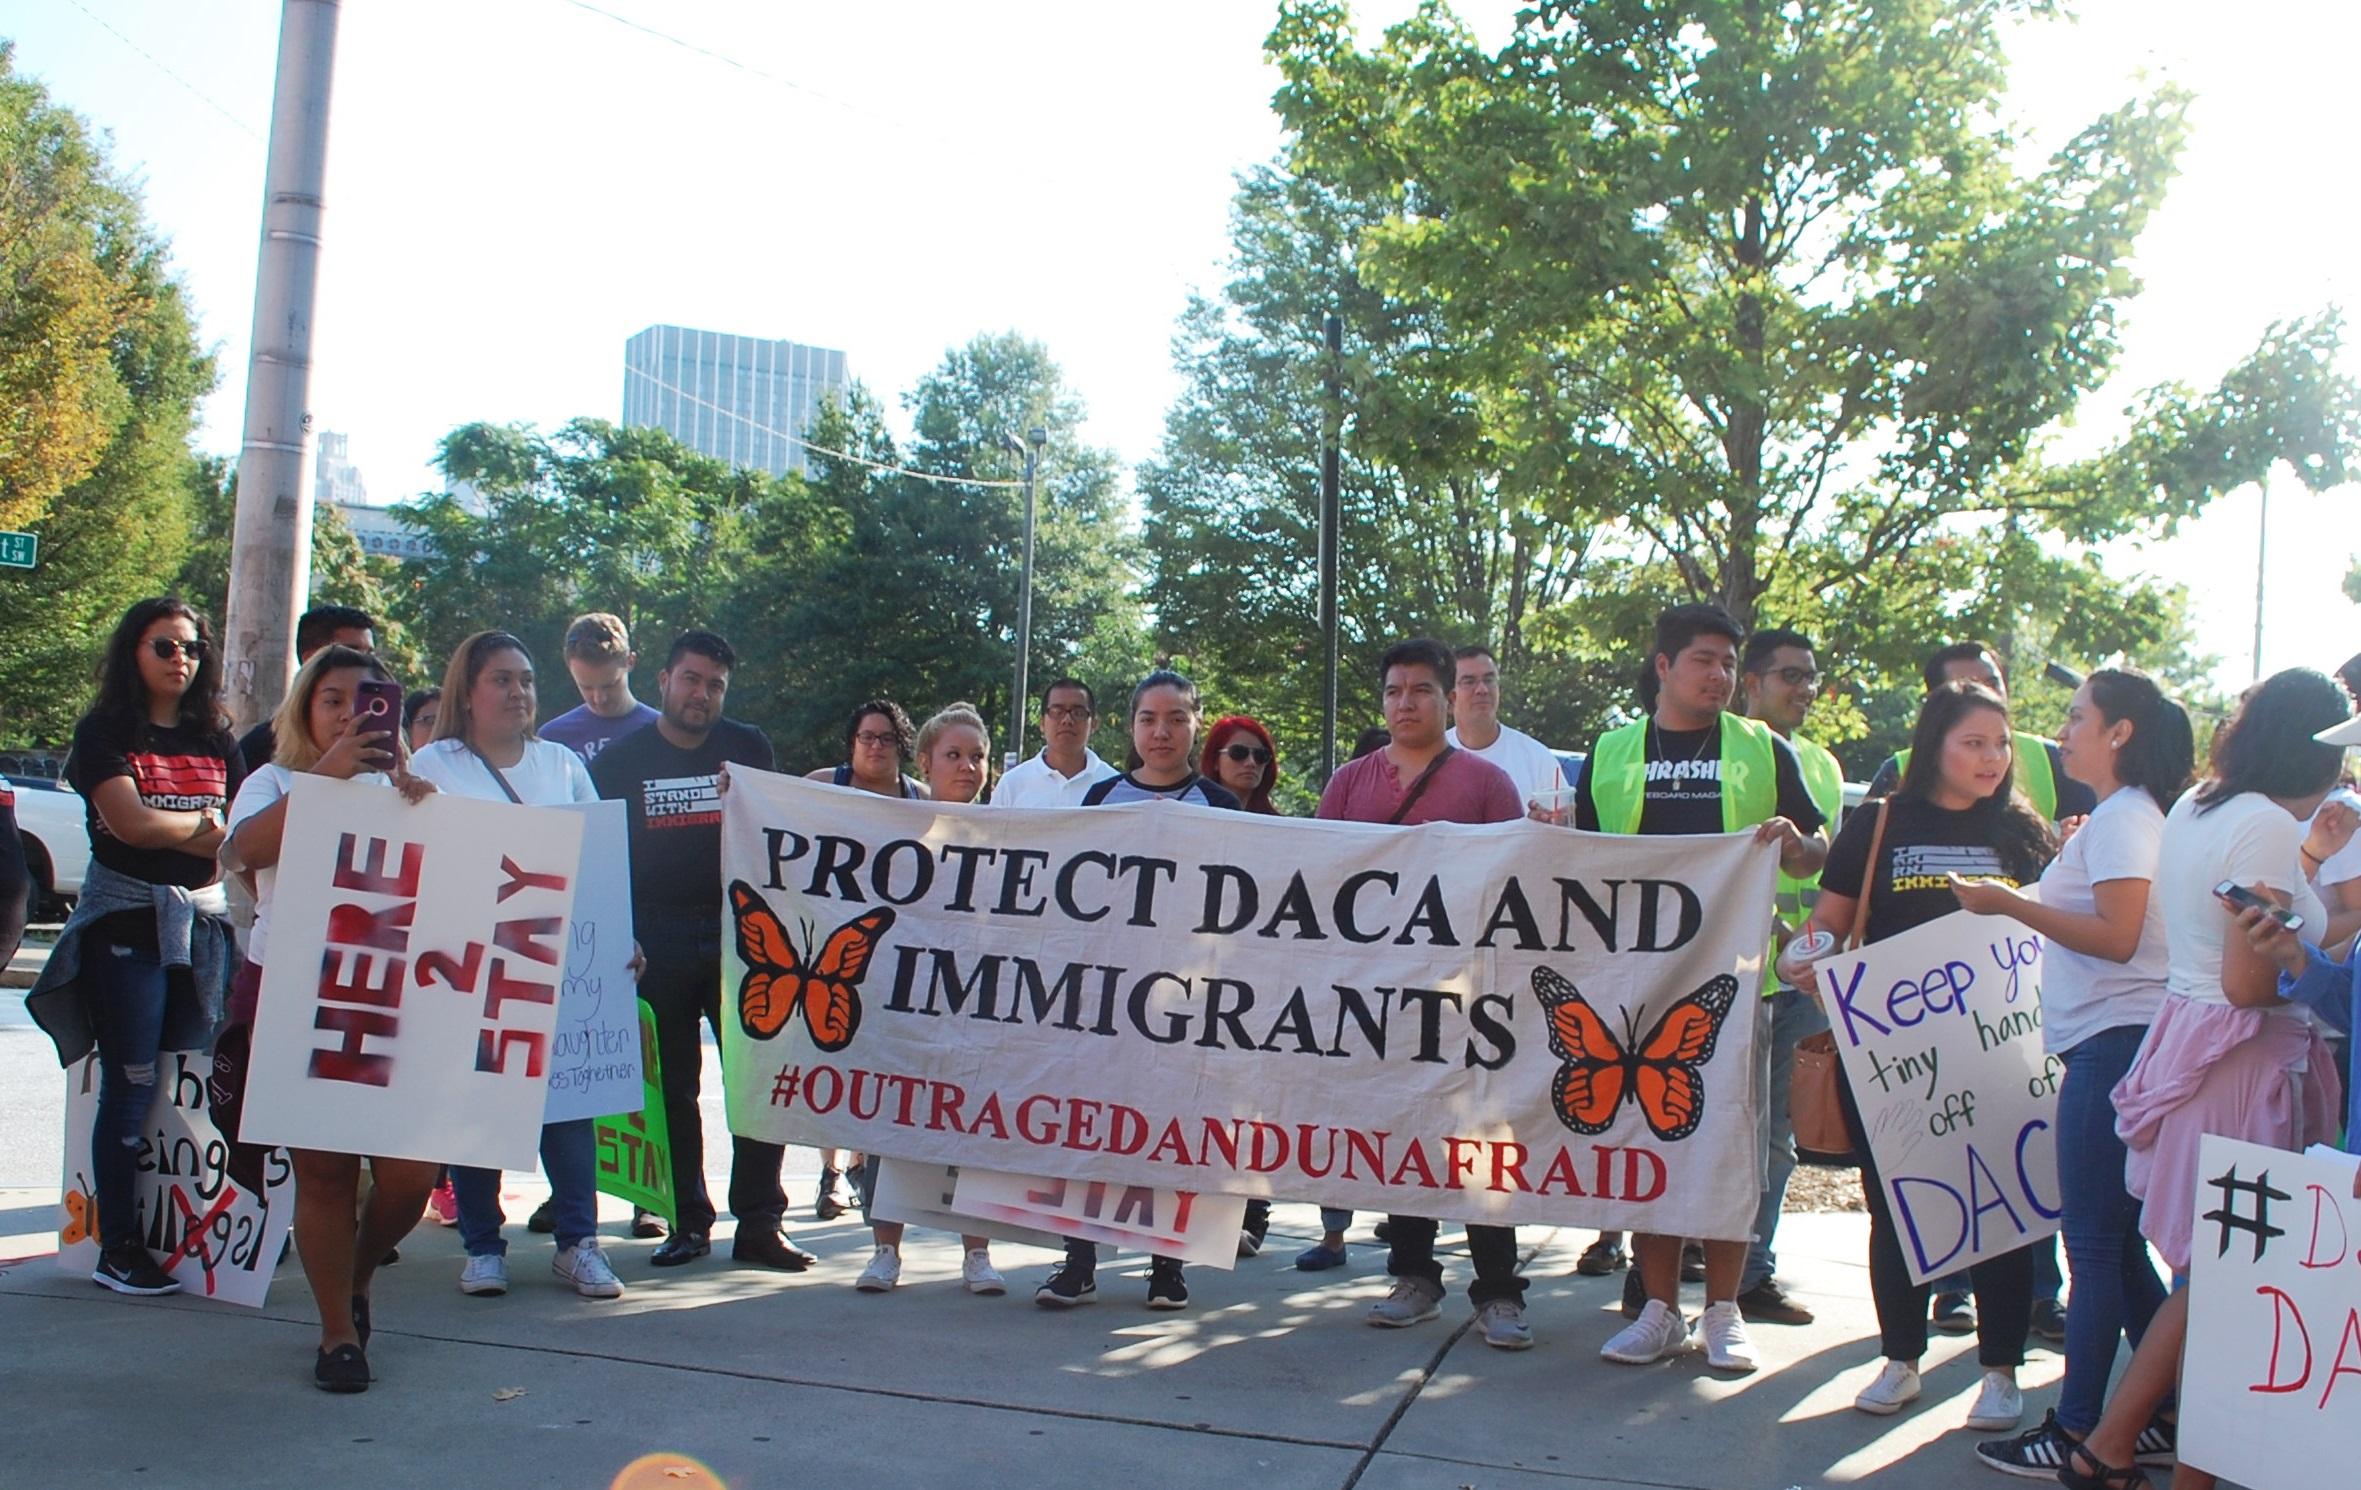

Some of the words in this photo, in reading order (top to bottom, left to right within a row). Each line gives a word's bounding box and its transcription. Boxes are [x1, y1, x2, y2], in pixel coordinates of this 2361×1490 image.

[644, 788, 701, 804] STAND
[762, 827, 1176, 928] PROTECT
[1192, 865, 1460, 946] DACA
[1475, 875, 1703, 953] AND
[308, 832, 424, 1087] HERE
[414, 940, 485, 993] 2
[474, 853, 568, 1078] STAY
[883, 944, 1517, 1071] IMMIGRANTS
[1827, 962, 1975, 1047] Keep
[555, 1020, 630, 1070] aughter
[1869, 1046, 1938, 1101] tiny
[770, 1064, 1668, 1203] #OUTRAGEDANDUNAFRAID
[1930, 1089, 1976, 1137] off
[1891, 1119, 2063, 1275] DAC
[2249, 1286, 2361, 1409] DA
